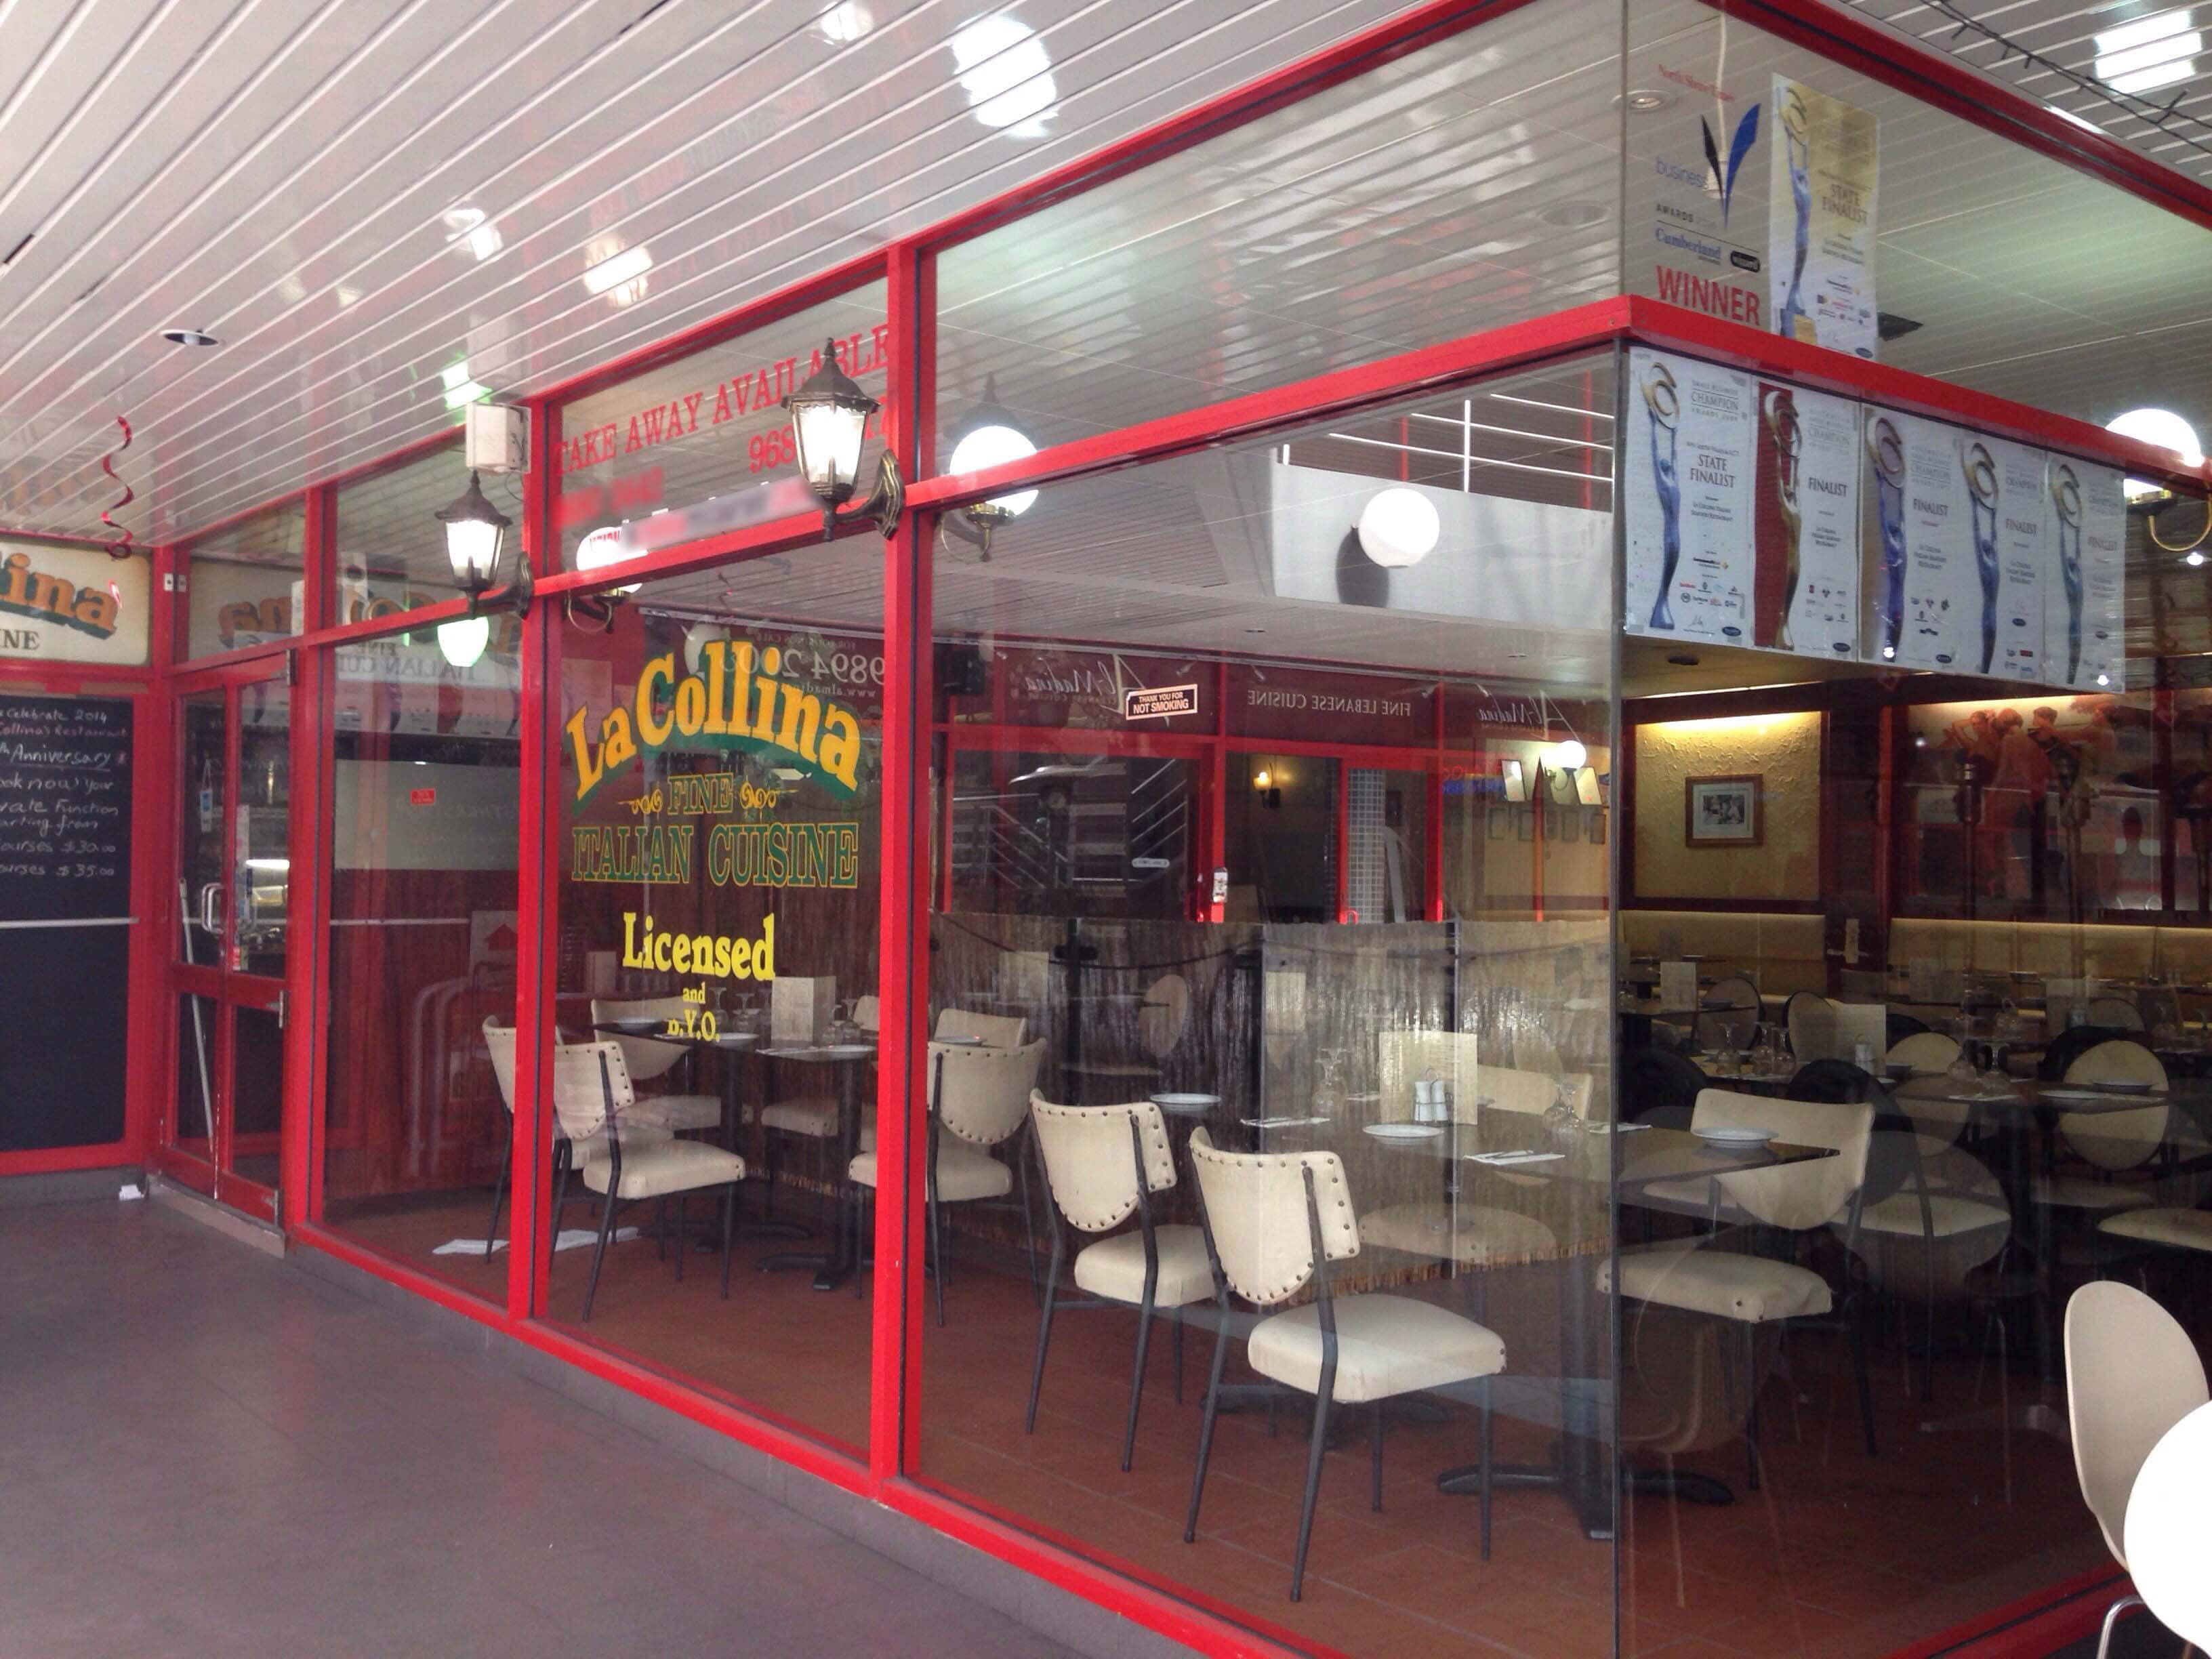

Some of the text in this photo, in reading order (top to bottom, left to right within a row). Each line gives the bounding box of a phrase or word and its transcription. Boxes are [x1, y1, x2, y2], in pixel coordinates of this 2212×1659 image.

[1656, 203, 1694, 223] AWARDS
[1655, 227, 1721, 260] Cumberland
[1656, 265, 1761, 326] WINNER
[623, 390, 703, 453] AWAY
[749, 424, 799, 473] 968
[1698, 453, 1727, 472] STATE
[1690, 468, 1737, 488] FINALIST
[1808, 476, 1849, 498] FINALIST
[1913, 498, 1949, 517] FINALIST
[2005, 518, 2038, 535] FINALIST
[0, 552, 118, 638] ina
[0, 628, 40, 651] NE
[1132, 699, 1189, 714] NOT SMOKING
[1139, 695, 1158, 703] THANK
[1159, 693, 1171, 701] YOU
[74, 708, 107, 724] 2014
[565, 639, 862, 804] La Collina
[11, 743, 111, 769] Anniversary
[85, 779, 115, 796] your
[667, 772, 734, 816] FINE
[0, 798, 48, 813] vate
[571, 821, 859, 889] ITALIAN CUISINE
[621, 912, 776, 981] Licensed
[682, 981, 706, 1004] and
